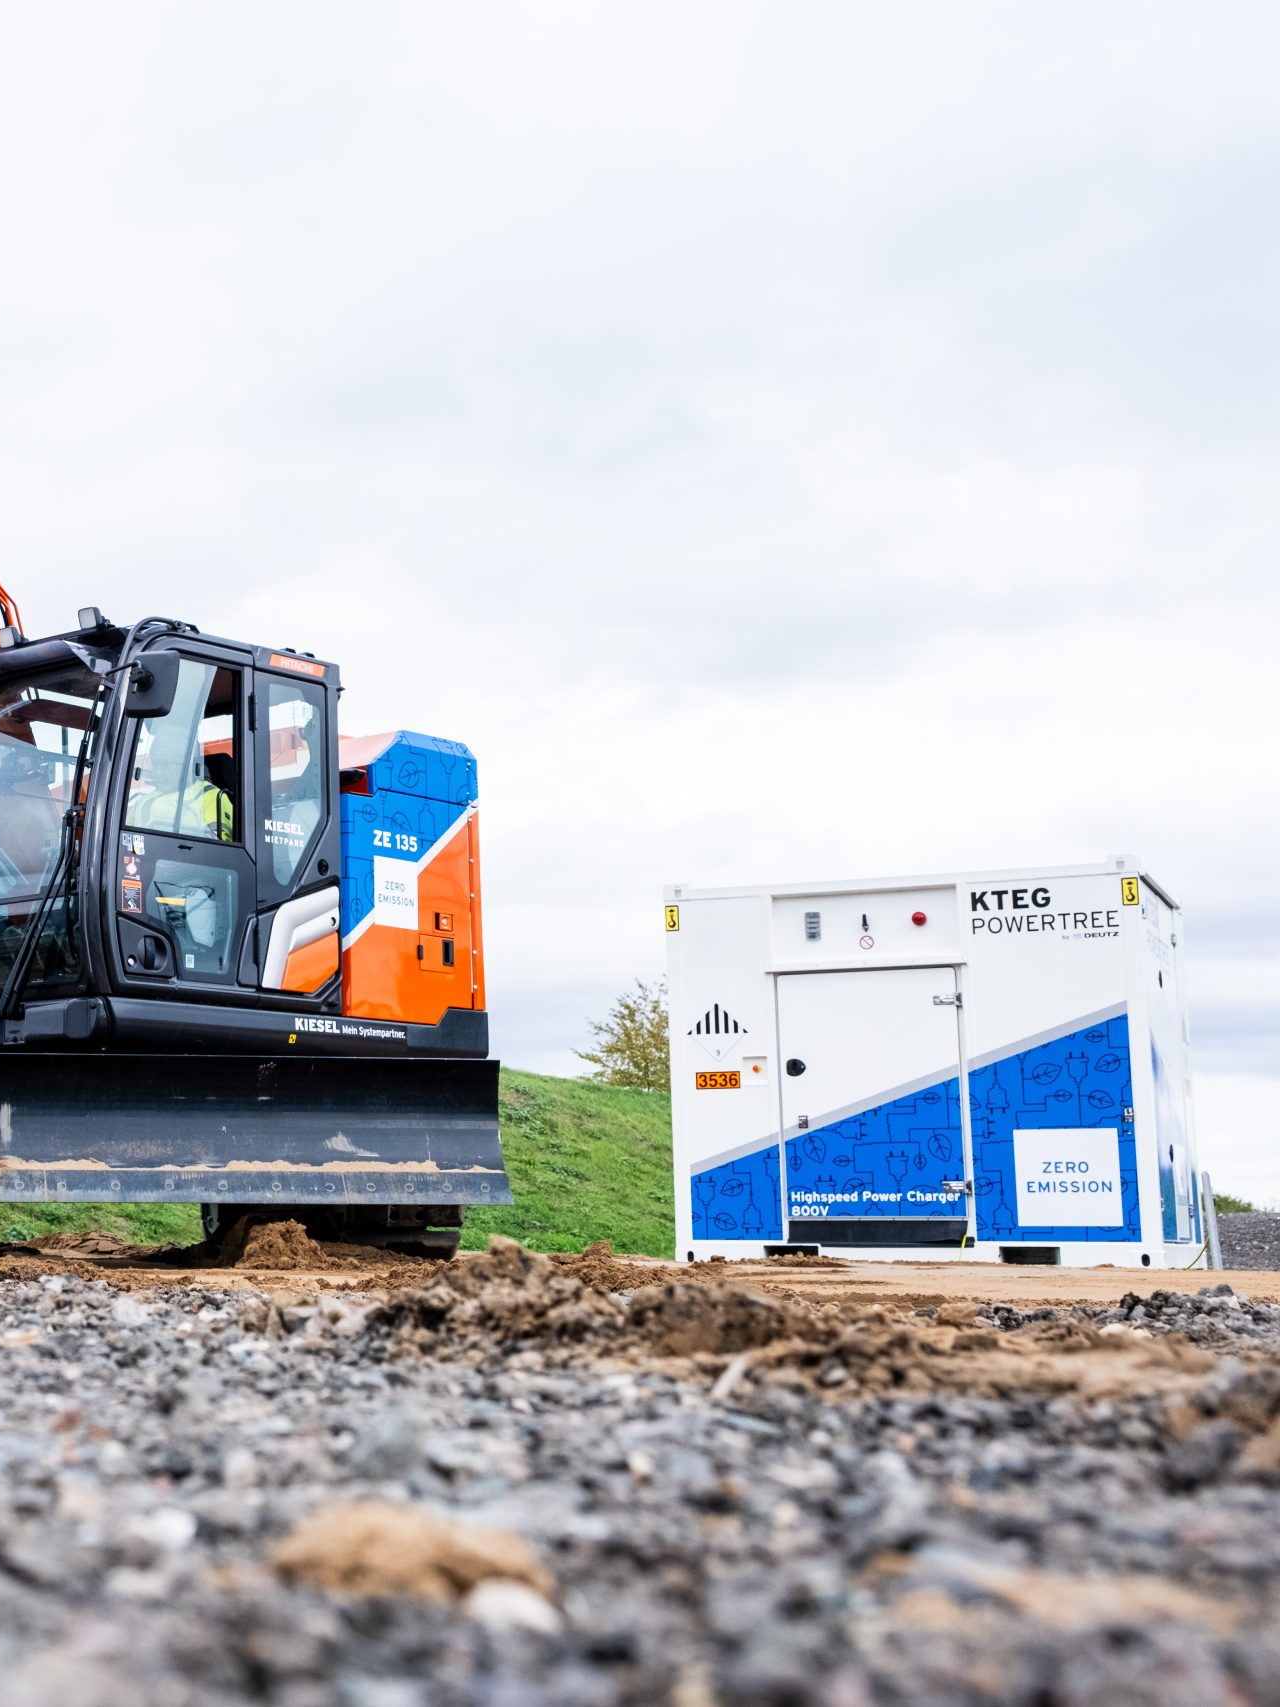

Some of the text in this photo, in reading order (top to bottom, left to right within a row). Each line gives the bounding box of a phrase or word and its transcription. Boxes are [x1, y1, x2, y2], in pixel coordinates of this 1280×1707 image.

[264, 819, 305, 836] KIESEL
[264, 834, 305, 848] MIETPARK
[373, 829, 418, 853] ZE 135
[385, 880, 406, 892] ZERO
[377, 893, 415, 907] EMISSION
[970, 887, 1051, 912] KTEG
[972, 910, 1119, 935] POWERTREE
[1084, 931, 1119, 939] DEUTZ
[294, 1017, 406, 1039] KIESEL Mein Systempartner.
[698, 1073, 739, 1087] 3536
[1042, 1161, 1089, 1174] ZERO
[1027, 1181, 1113, 1193] EMISSION
[791, 1190, 961, 1204] Highspeed Power Charger
[791, 1205, 829, 1216] 800V
